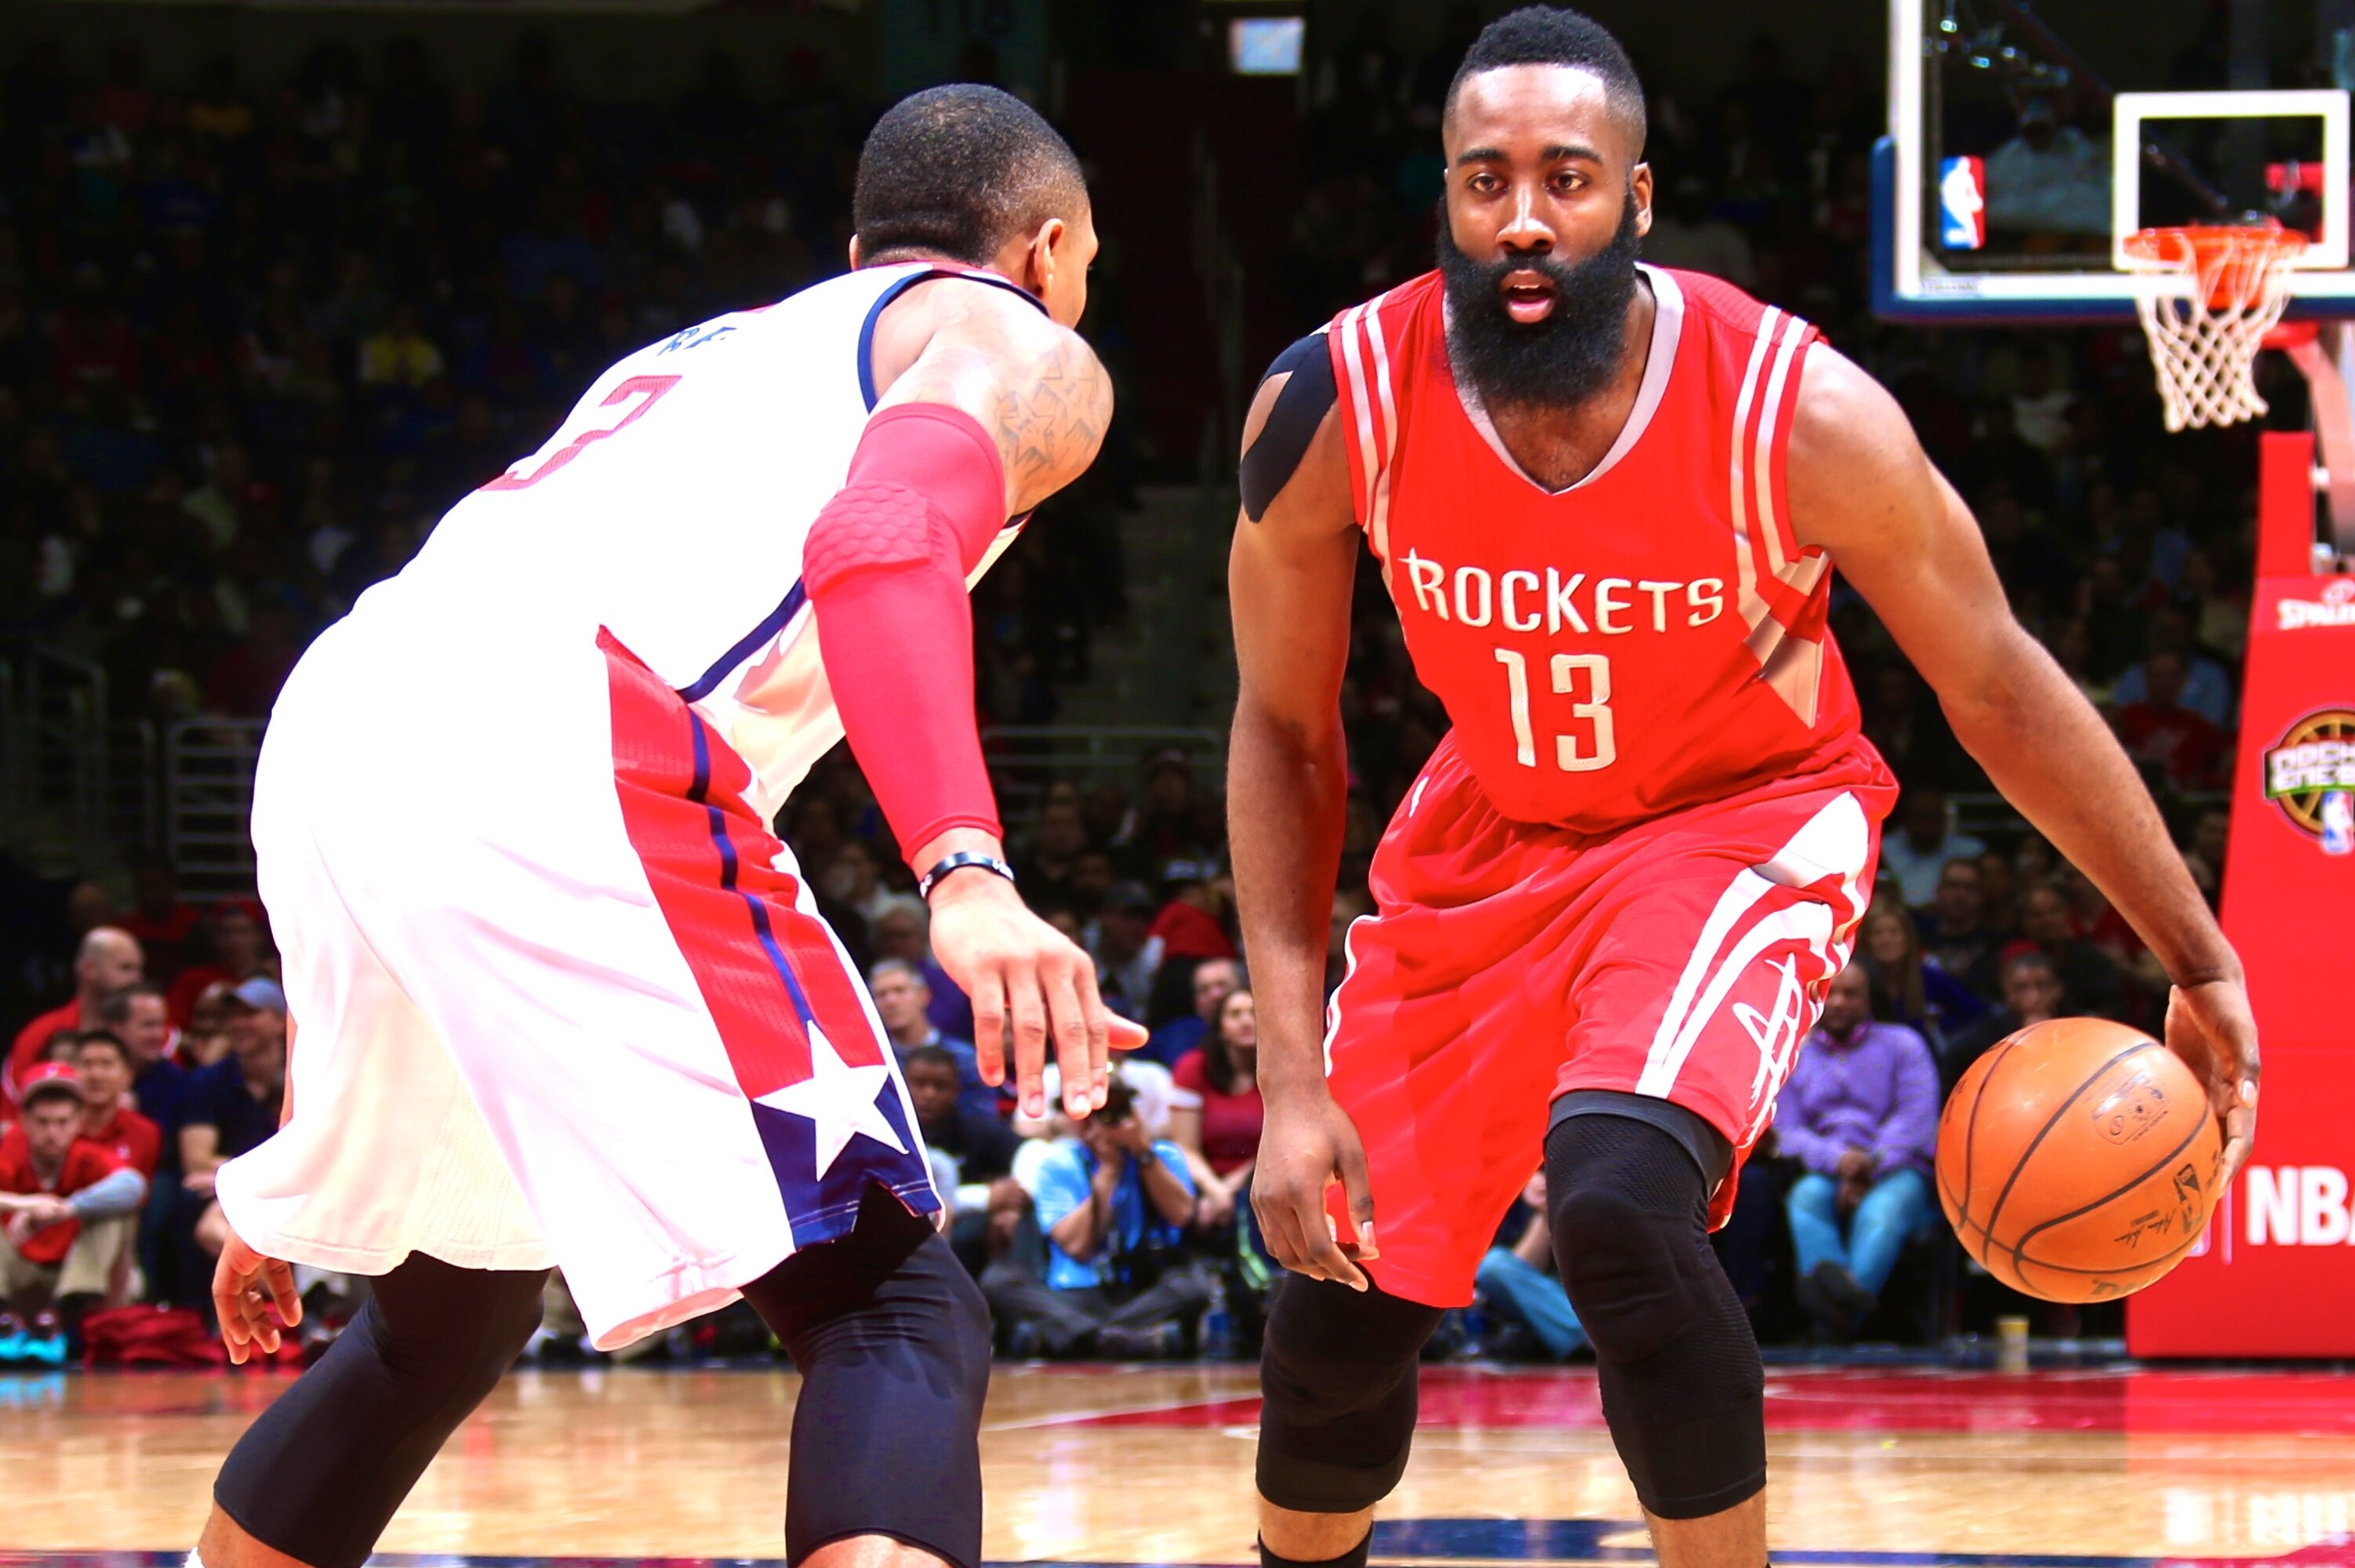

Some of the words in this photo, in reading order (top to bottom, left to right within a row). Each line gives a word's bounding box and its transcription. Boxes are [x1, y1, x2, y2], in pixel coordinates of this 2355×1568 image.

[1398, 546, 1725, 637] ROCKETS
[1494, 648, 1617, 772] 13
[2246, 1164, 2355, 1247] NB
